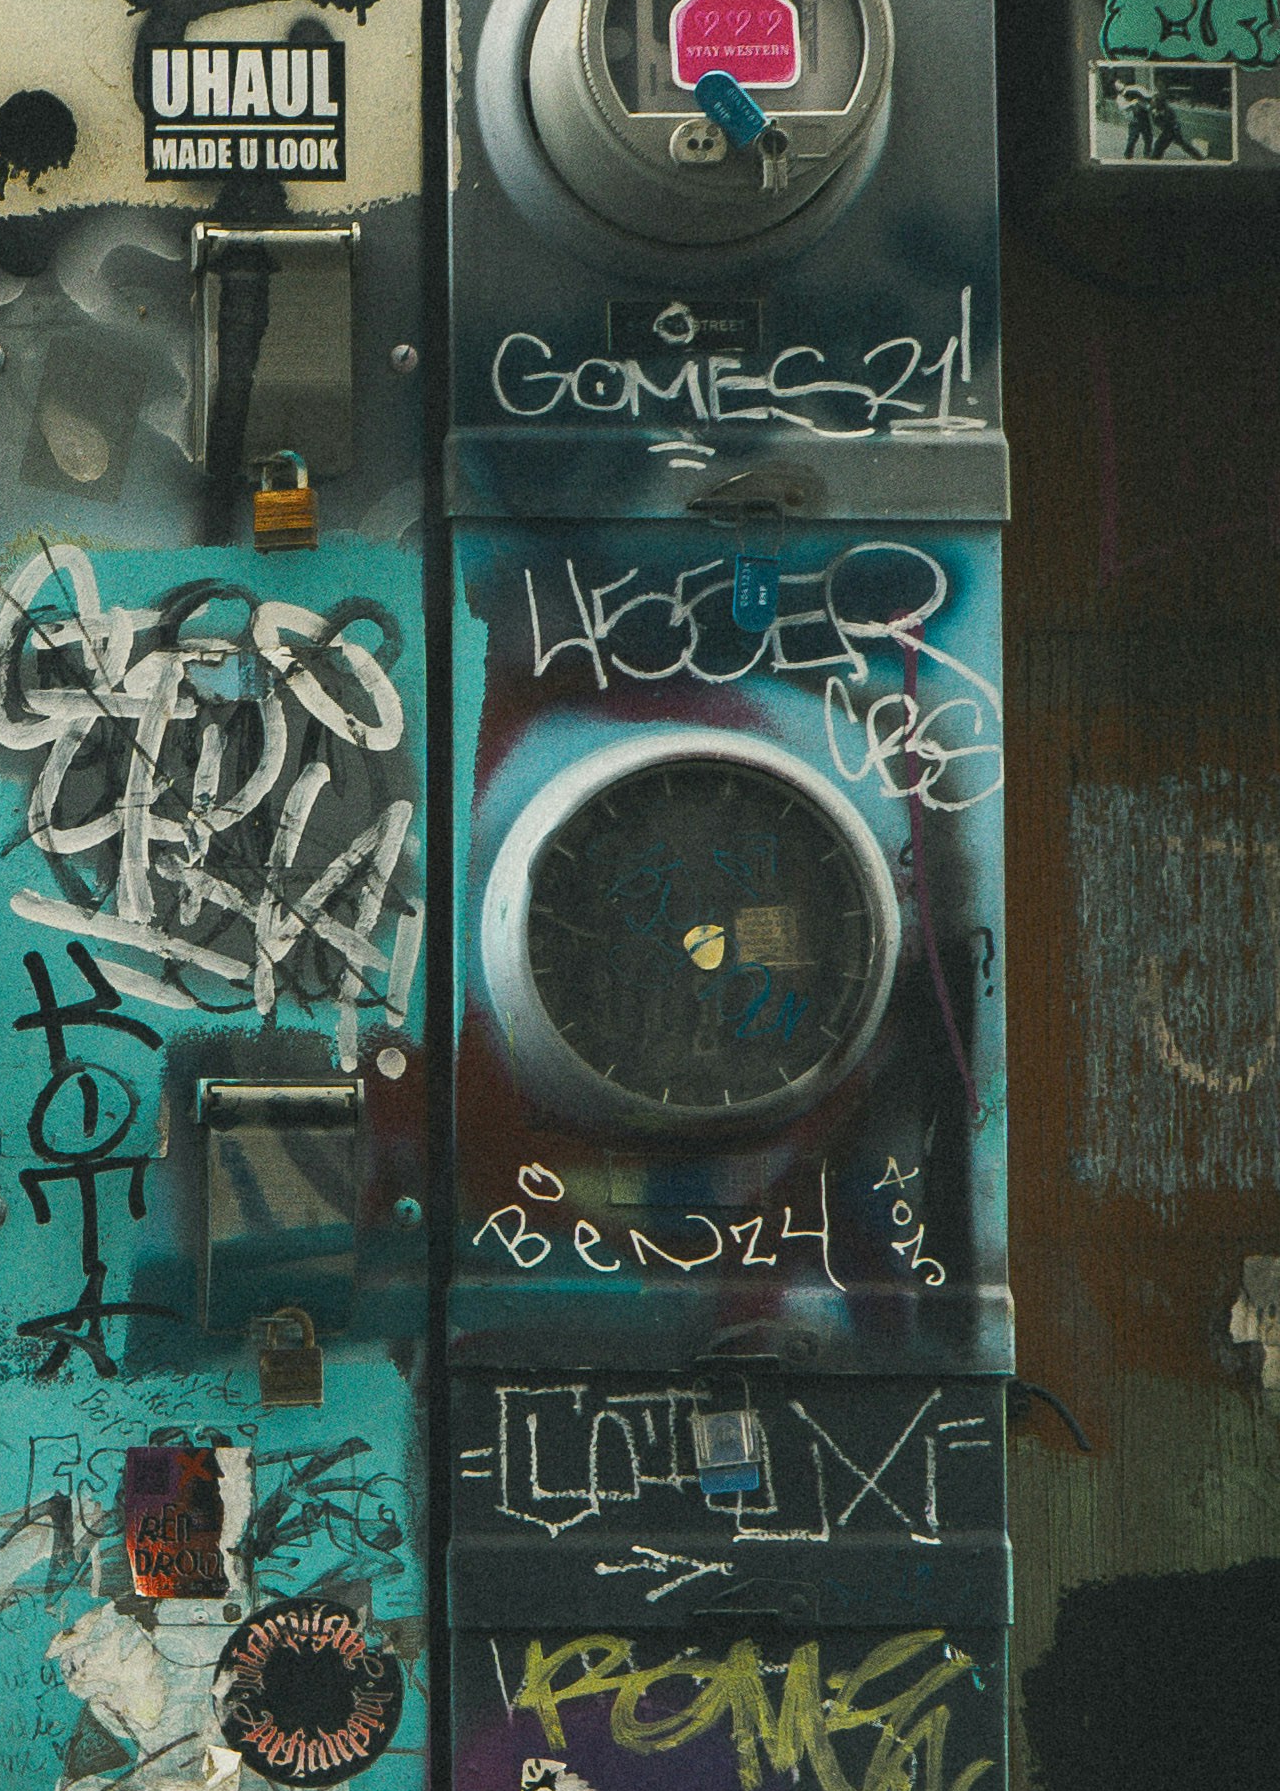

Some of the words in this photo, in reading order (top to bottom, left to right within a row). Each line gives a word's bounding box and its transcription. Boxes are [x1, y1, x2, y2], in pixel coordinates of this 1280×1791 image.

[686, 45, 721, 58] STAY
[723, 44, 791, 58] WESTERN
[152, 48, 339, 118] UHAUL
[152, 138, 233, 171] MADE
[239, 138, 259, 171] U
[266, 138, 339, 171] LOOK
